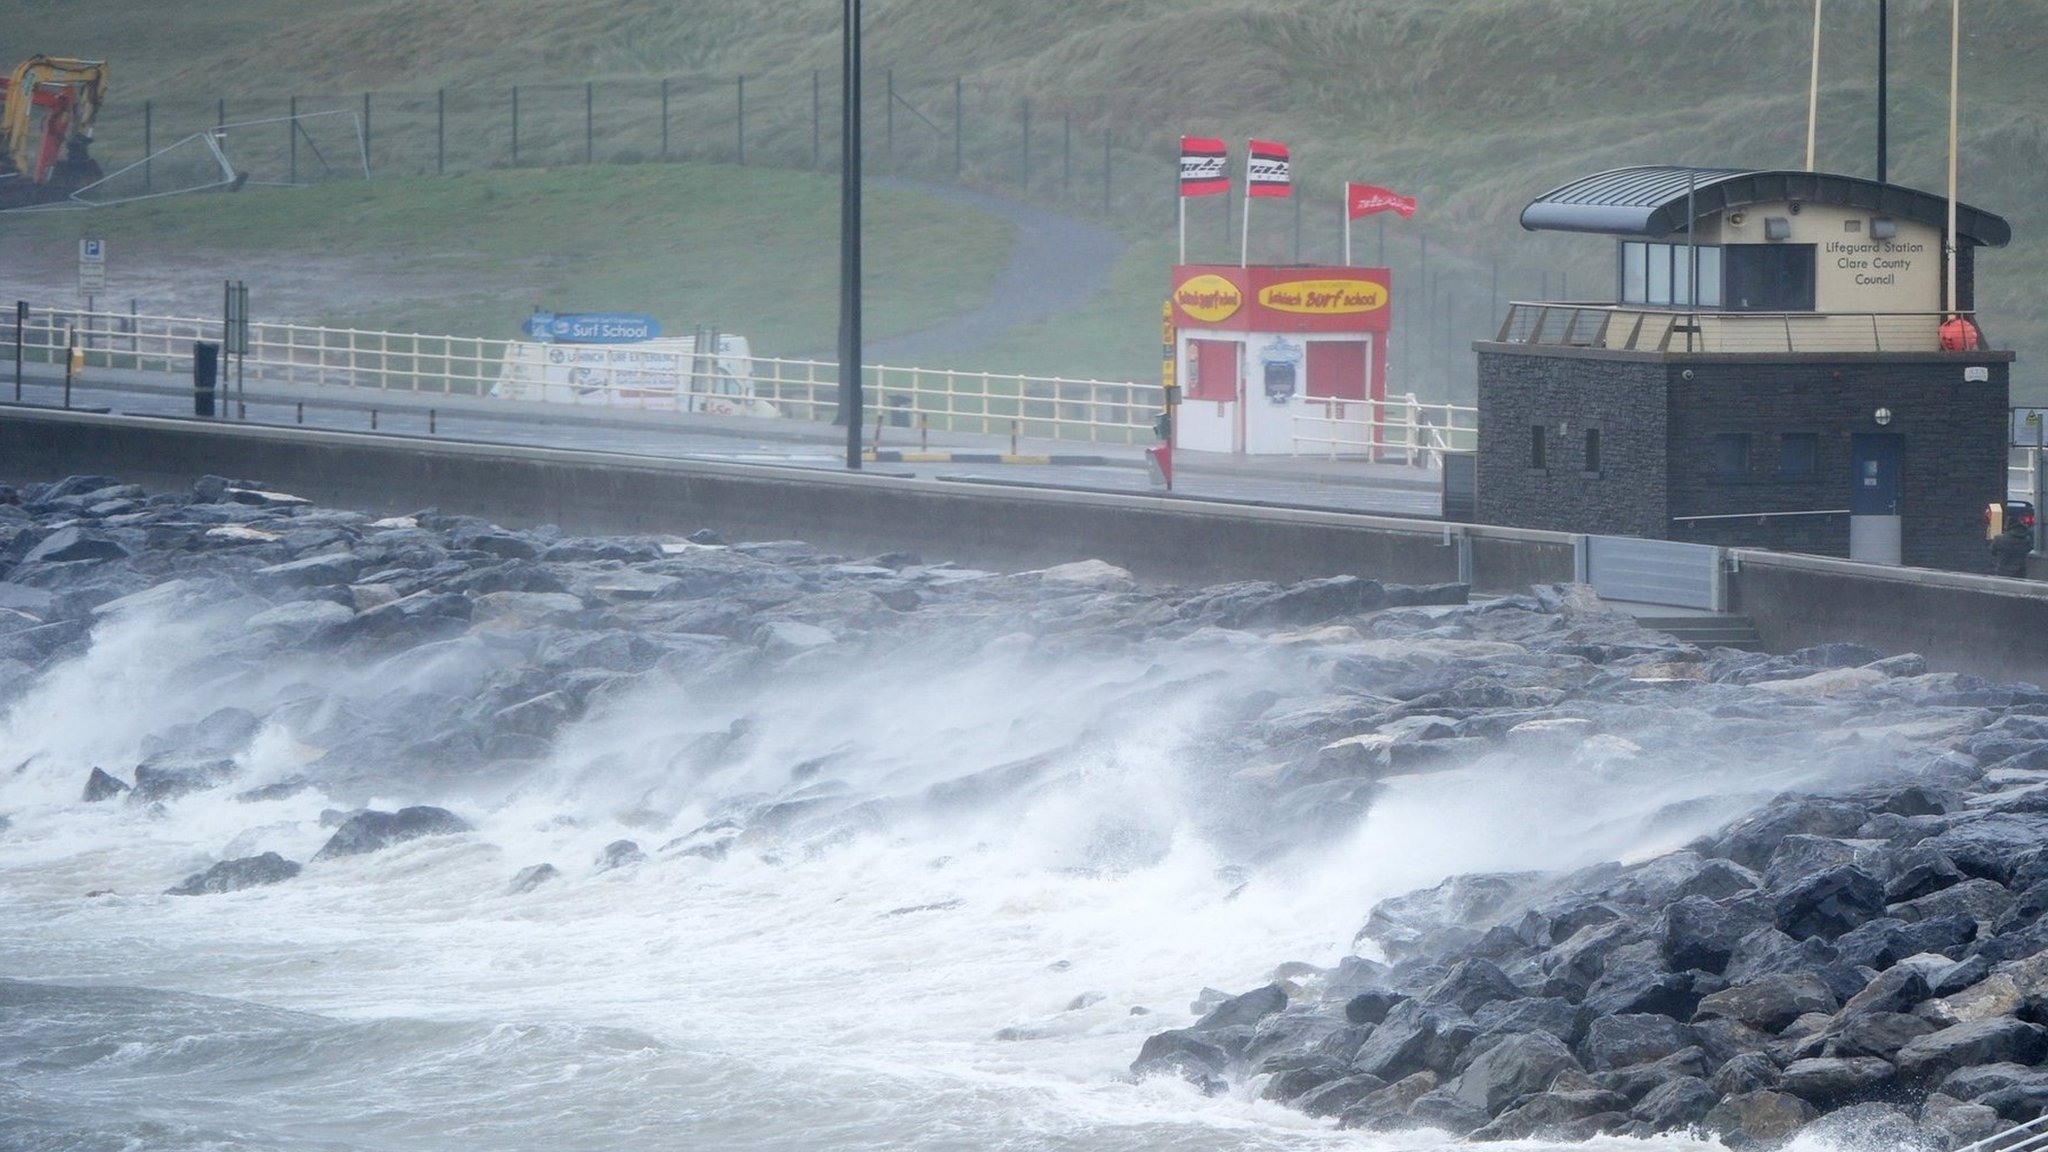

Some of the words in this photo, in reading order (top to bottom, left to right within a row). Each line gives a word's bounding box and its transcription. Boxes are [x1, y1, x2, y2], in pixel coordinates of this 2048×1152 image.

[1826, 242, 1880, 255] Lifeguard
[1884, 241, 1923, 253] Station
[1837, 257, 1868, 269] Clare
[1873, 257, 1911, 271] County
[1855, 273, 1895, 285] Council
[573, 324, 598, 337] Surf
[602, 324, 648, 338] School
